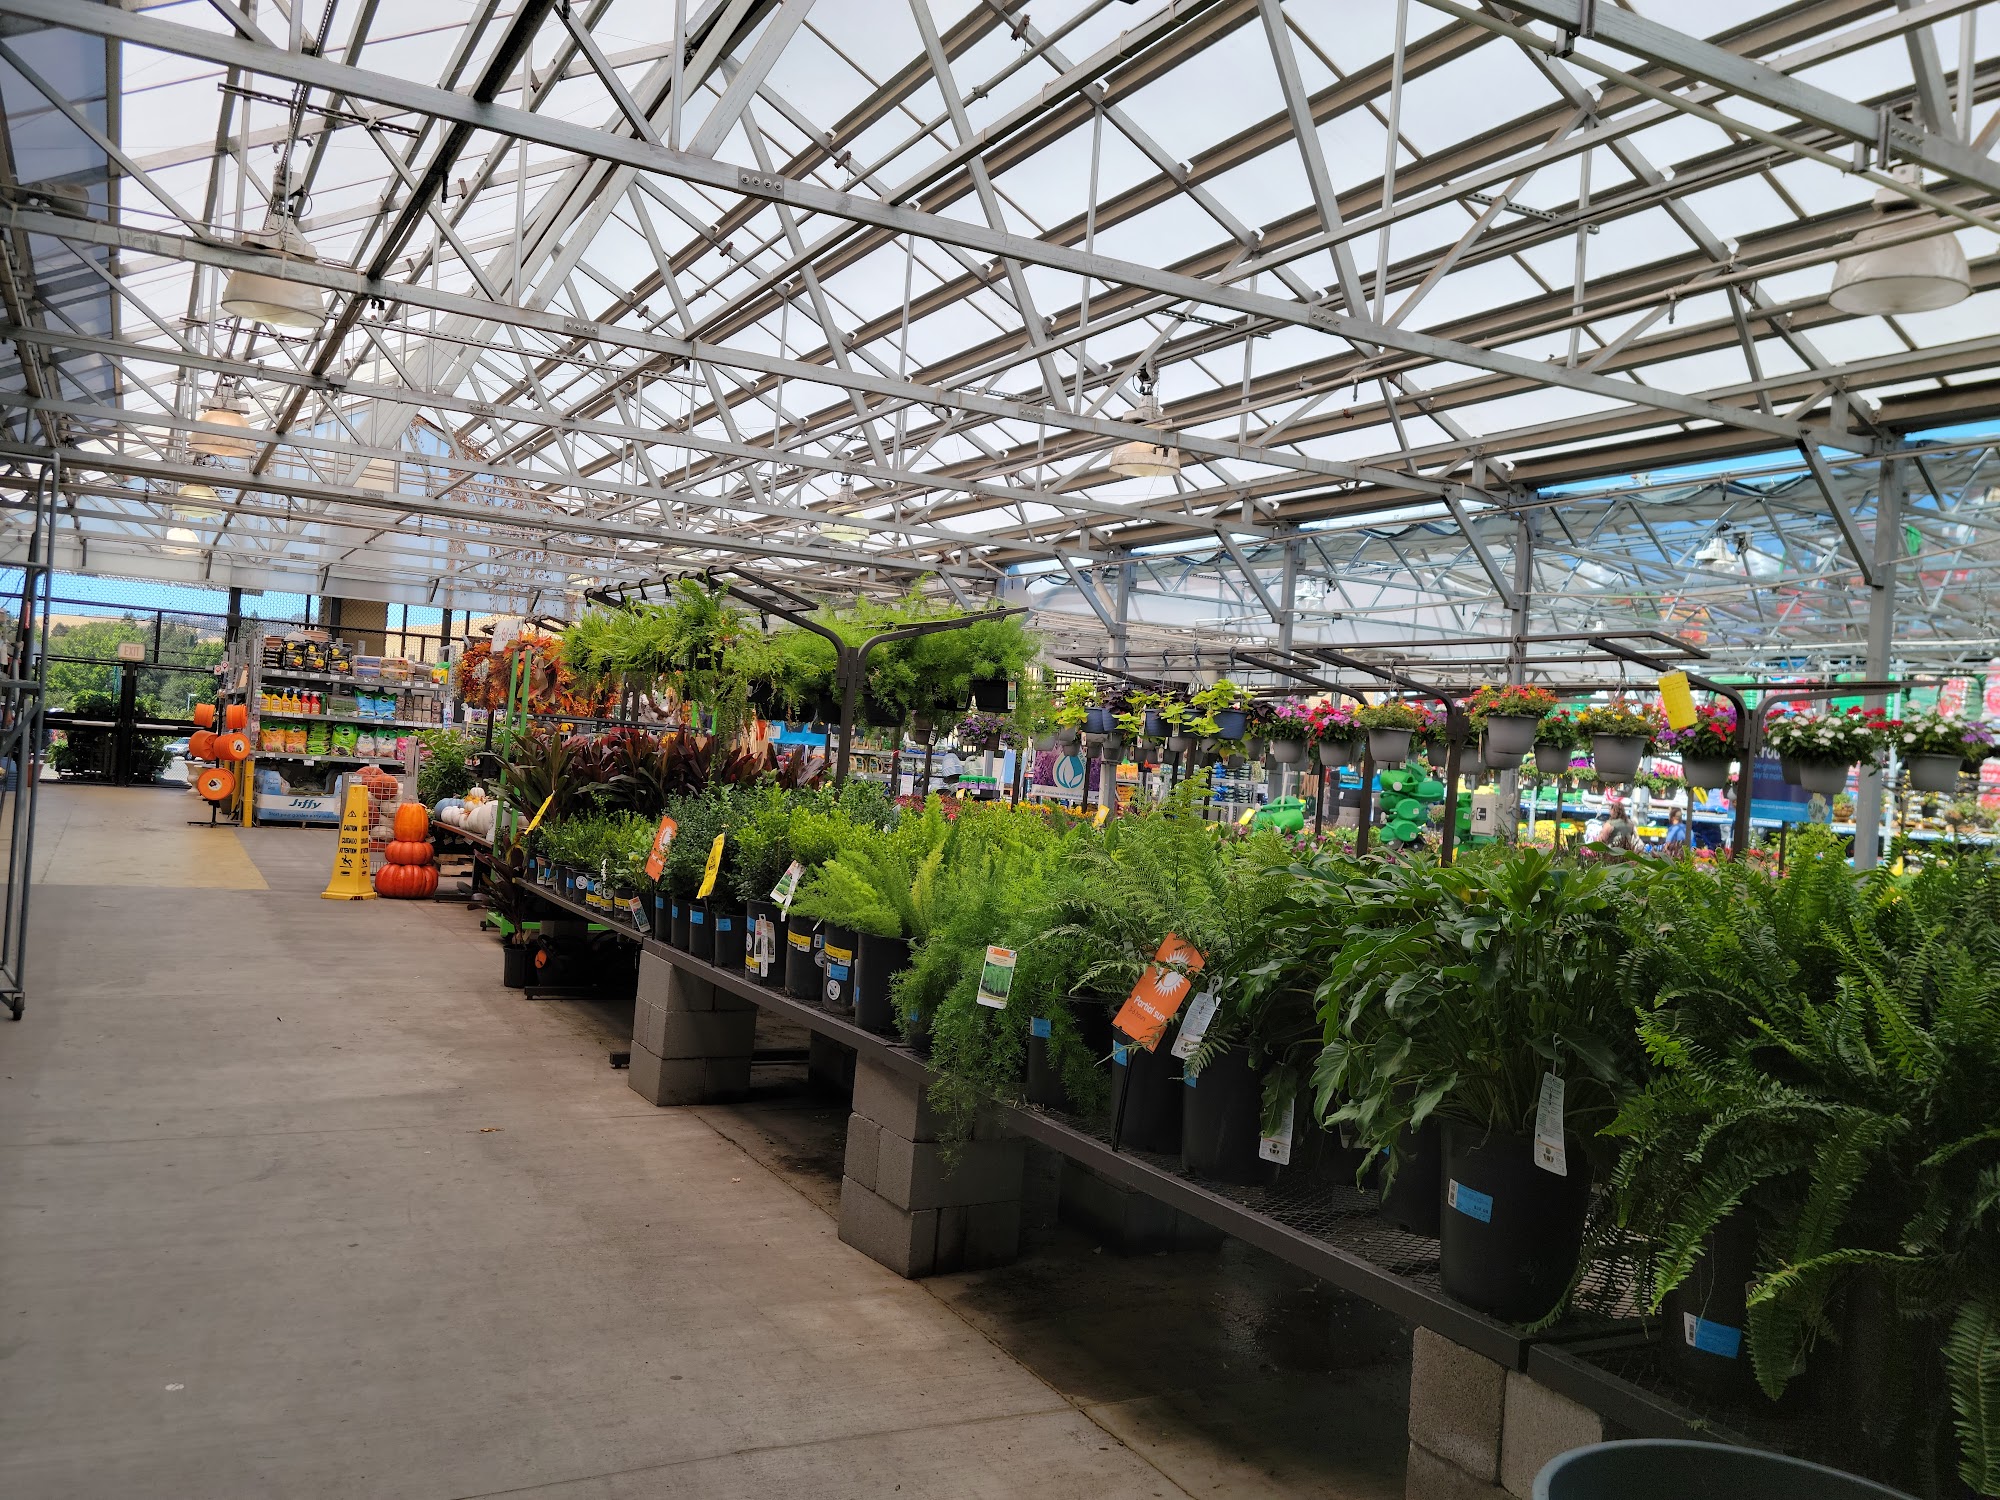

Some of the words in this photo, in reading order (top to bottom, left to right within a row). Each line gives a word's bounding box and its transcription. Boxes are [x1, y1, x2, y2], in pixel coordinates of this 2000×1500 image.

[124, 645, 141, 657] EXIT
[289, 798, 322, 809] Jiffy
[343, 824, 358, 832] CAUTION
[341, 837, 357, 845] CUIDADO
[1133, 995, 1155, 1015] Partial
[1153, 1010, 1166, 1023] sun
[1134, 1010, 1146, 1022] hours
